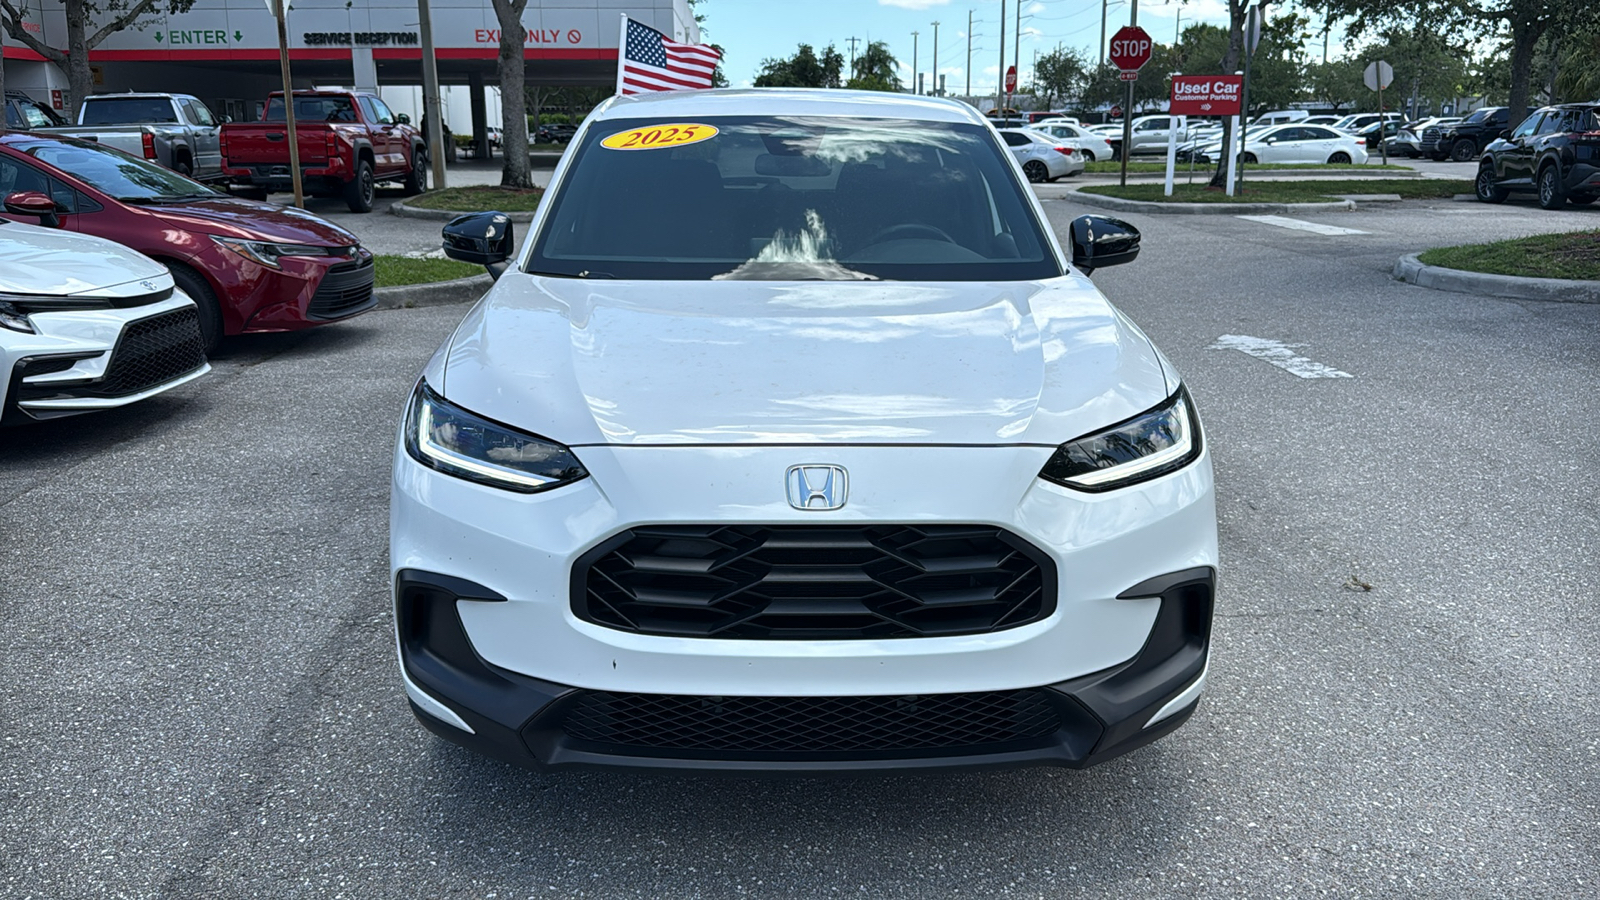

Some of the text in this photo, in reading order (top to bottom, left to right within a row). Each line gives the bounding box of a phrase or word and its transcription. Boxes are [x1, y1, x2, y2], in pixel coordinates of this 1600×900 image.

[169, 30, 228, 44] ENTER
[303, 31, 418, 45] SERVICE RECEPTION
[475, 29, 560, 43] EXI NLY
[1112, 40, 1149, 57] STOP
[1174, 81, 1240, 94] Used Car
[1210, 94, 1238, 102] Parking
[620, 126, 700, 148] 2025
